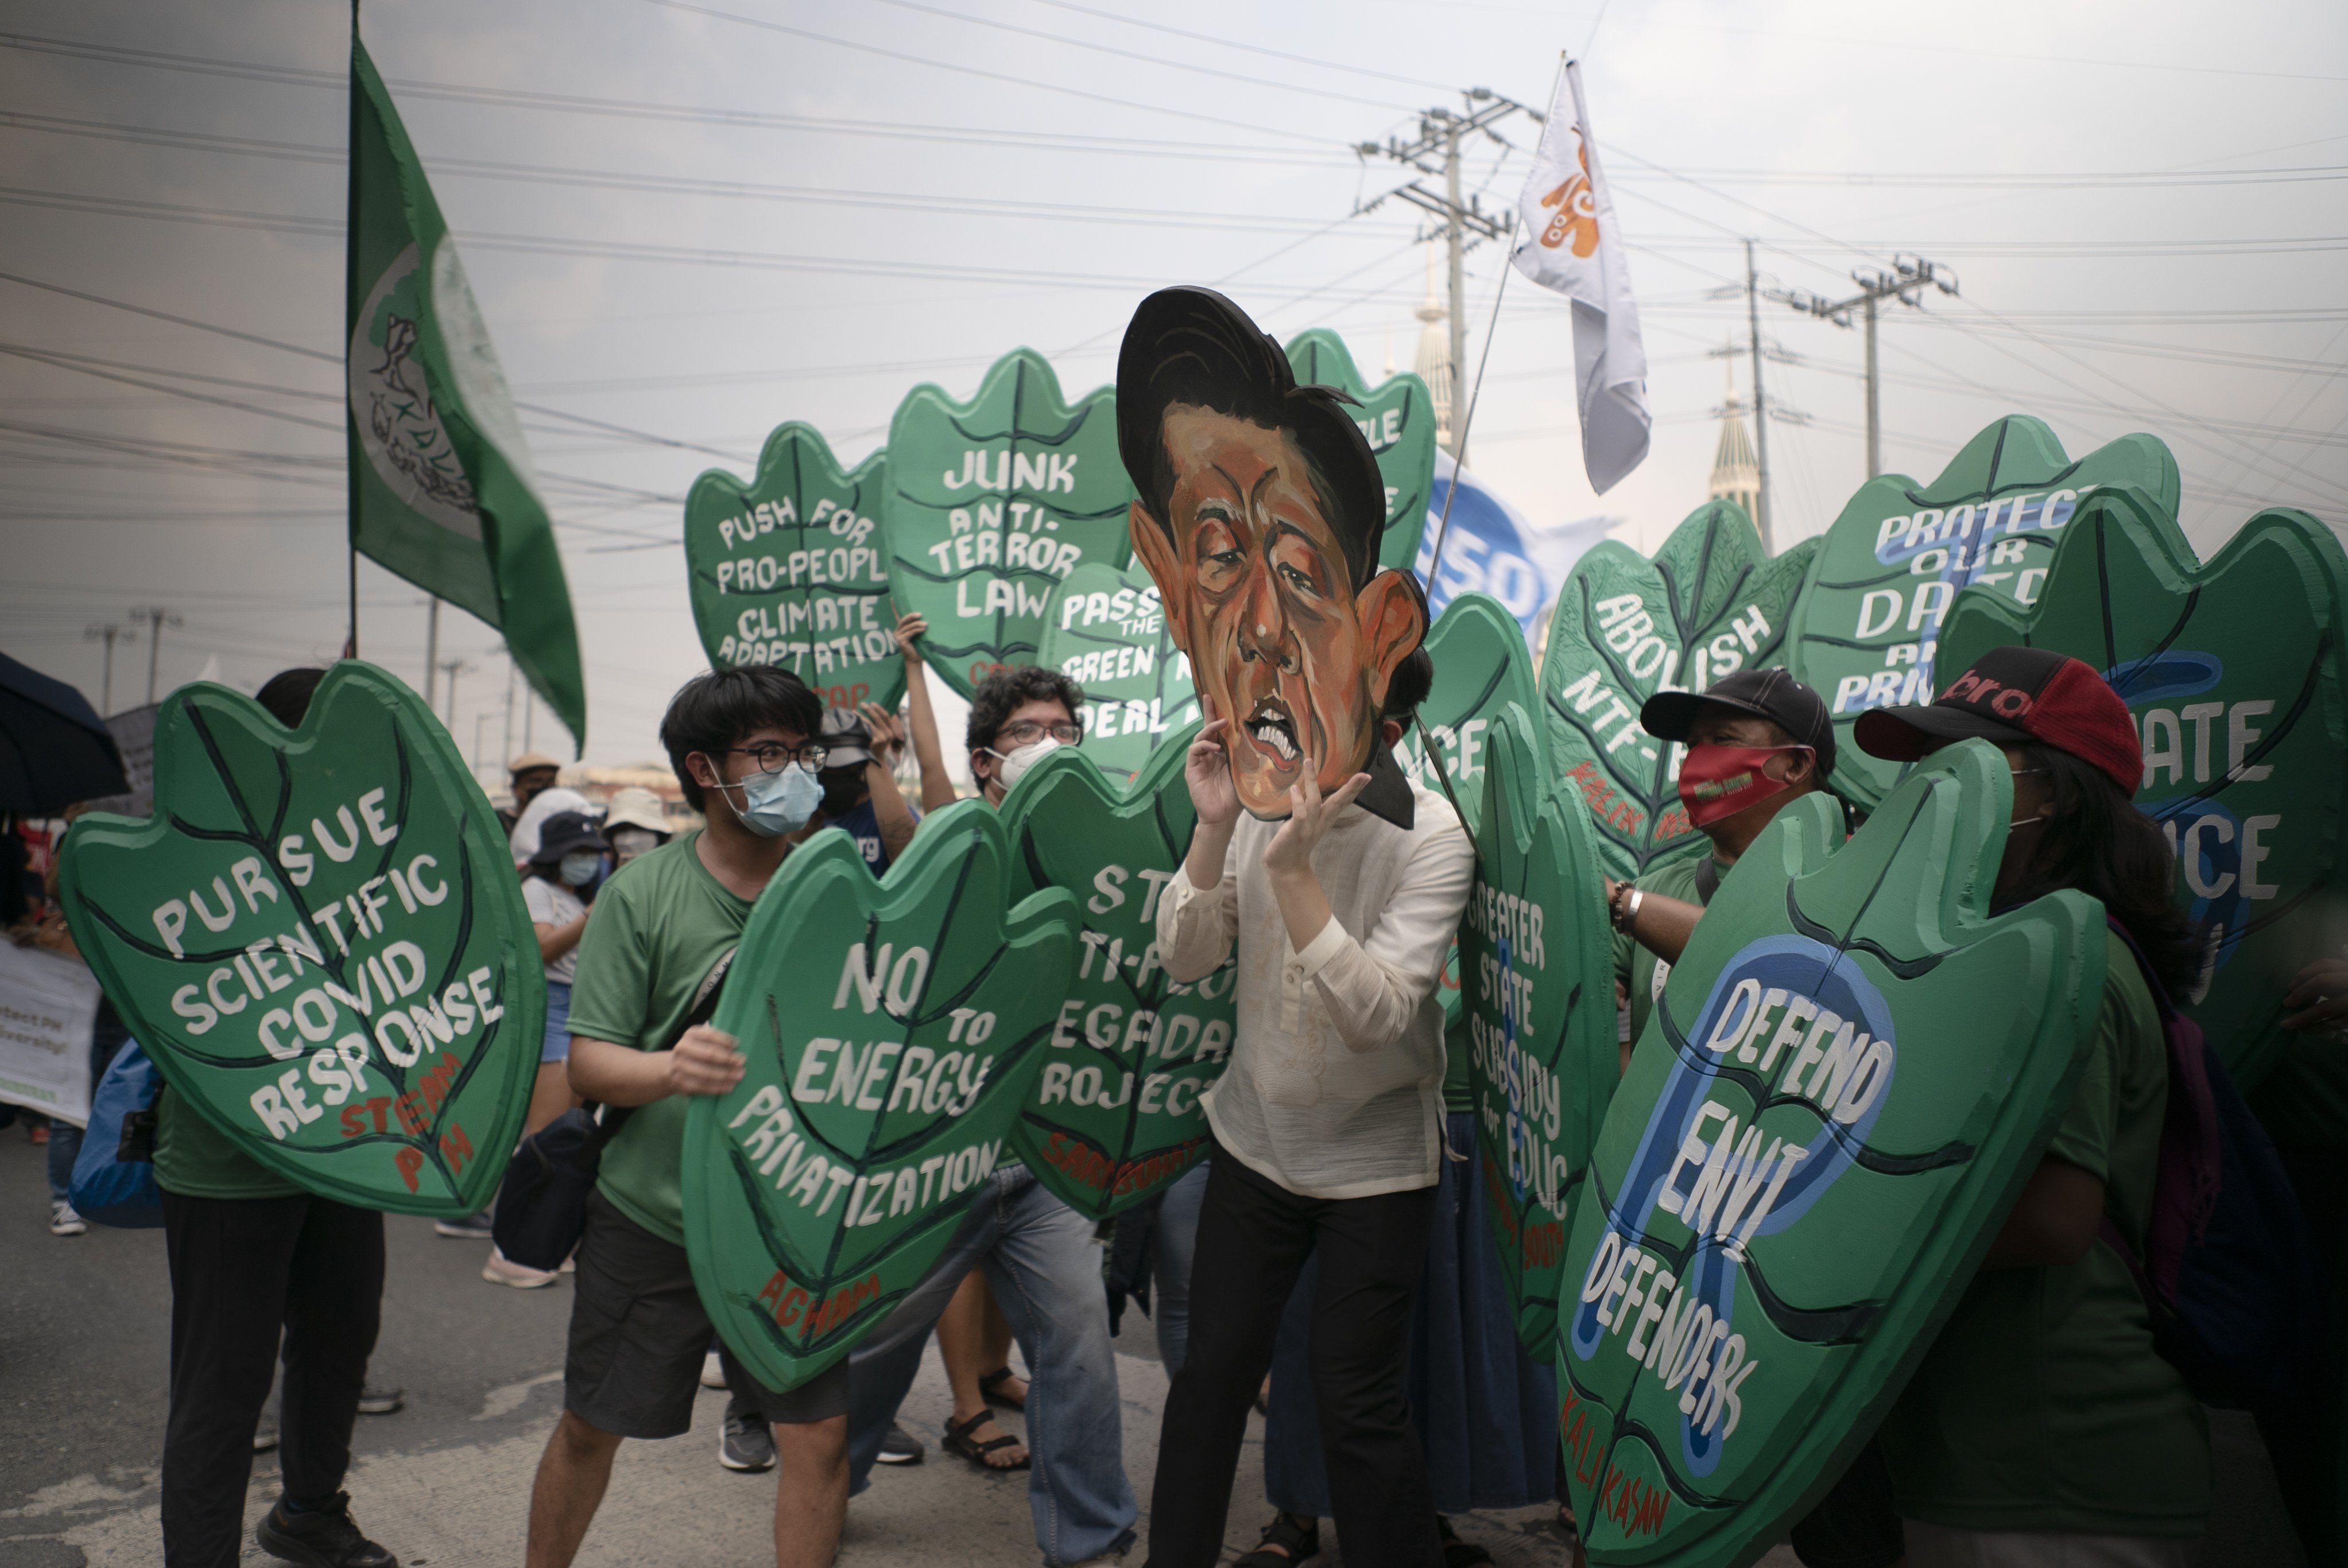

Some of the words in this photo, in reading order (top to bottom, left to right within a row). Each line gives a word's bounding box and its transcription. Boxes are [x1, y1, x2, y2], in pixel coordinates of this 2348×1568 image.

[944, 449, 1078, 493] JUNK
[718, 495, 796, 550] PUSH
[809, 498, 874, 547] FOR
[950, 502, 1059, 536] ANTI-
[717, 548, 888, 595] PRO-PEOPL
[928, 531, 1082, 580] TERROR
[1910, 538, 2028, 575] OUR
[737, 595, 879, 642] CLIMATE
[957, 579, 1051, 619] LAW
[1061, 585, 1163, 630] PASS
[1118, 614, 1163, 636] THE
[1061, 643, 1155, 684] GREEN
[1596, 593, 1771, 694] ABOLISH
[1073, 697, 1171, 739] DEAL
[153, 787, 398, 959] PURSUE
[172, 855, 448, 1035] SCIENTIFIC
[1467, 880, 1545, 971] GREATER
[258, 941, 426, 1060] COVID
[832, 942, 931, 1016] NO
[1480, 952, 1534, 1037] STATE
[250, 967, 504, 1140] RESPONSE
[947, 1007, 997, 1046] TO
[1051, 1000, 1233, 1064] EGADA
[1706, 978, 1893, 1124] DEFEND
[340, 1051, 463, 1138] STEAM
[791, 1037, 994, 1117] ENERGY
[1471, 1011, 1561, 1141] SUBSIDY
[1482, 1090, 1500, 1139] for
[727, 1084, 1002, 1228] PRIVATIZATION
[1506, 1111, 1568, 1221] EDUC
[756, 1270, 881, 1340] AGHAM
[1581, 1232, 1760, 1441] DEFENDERS
